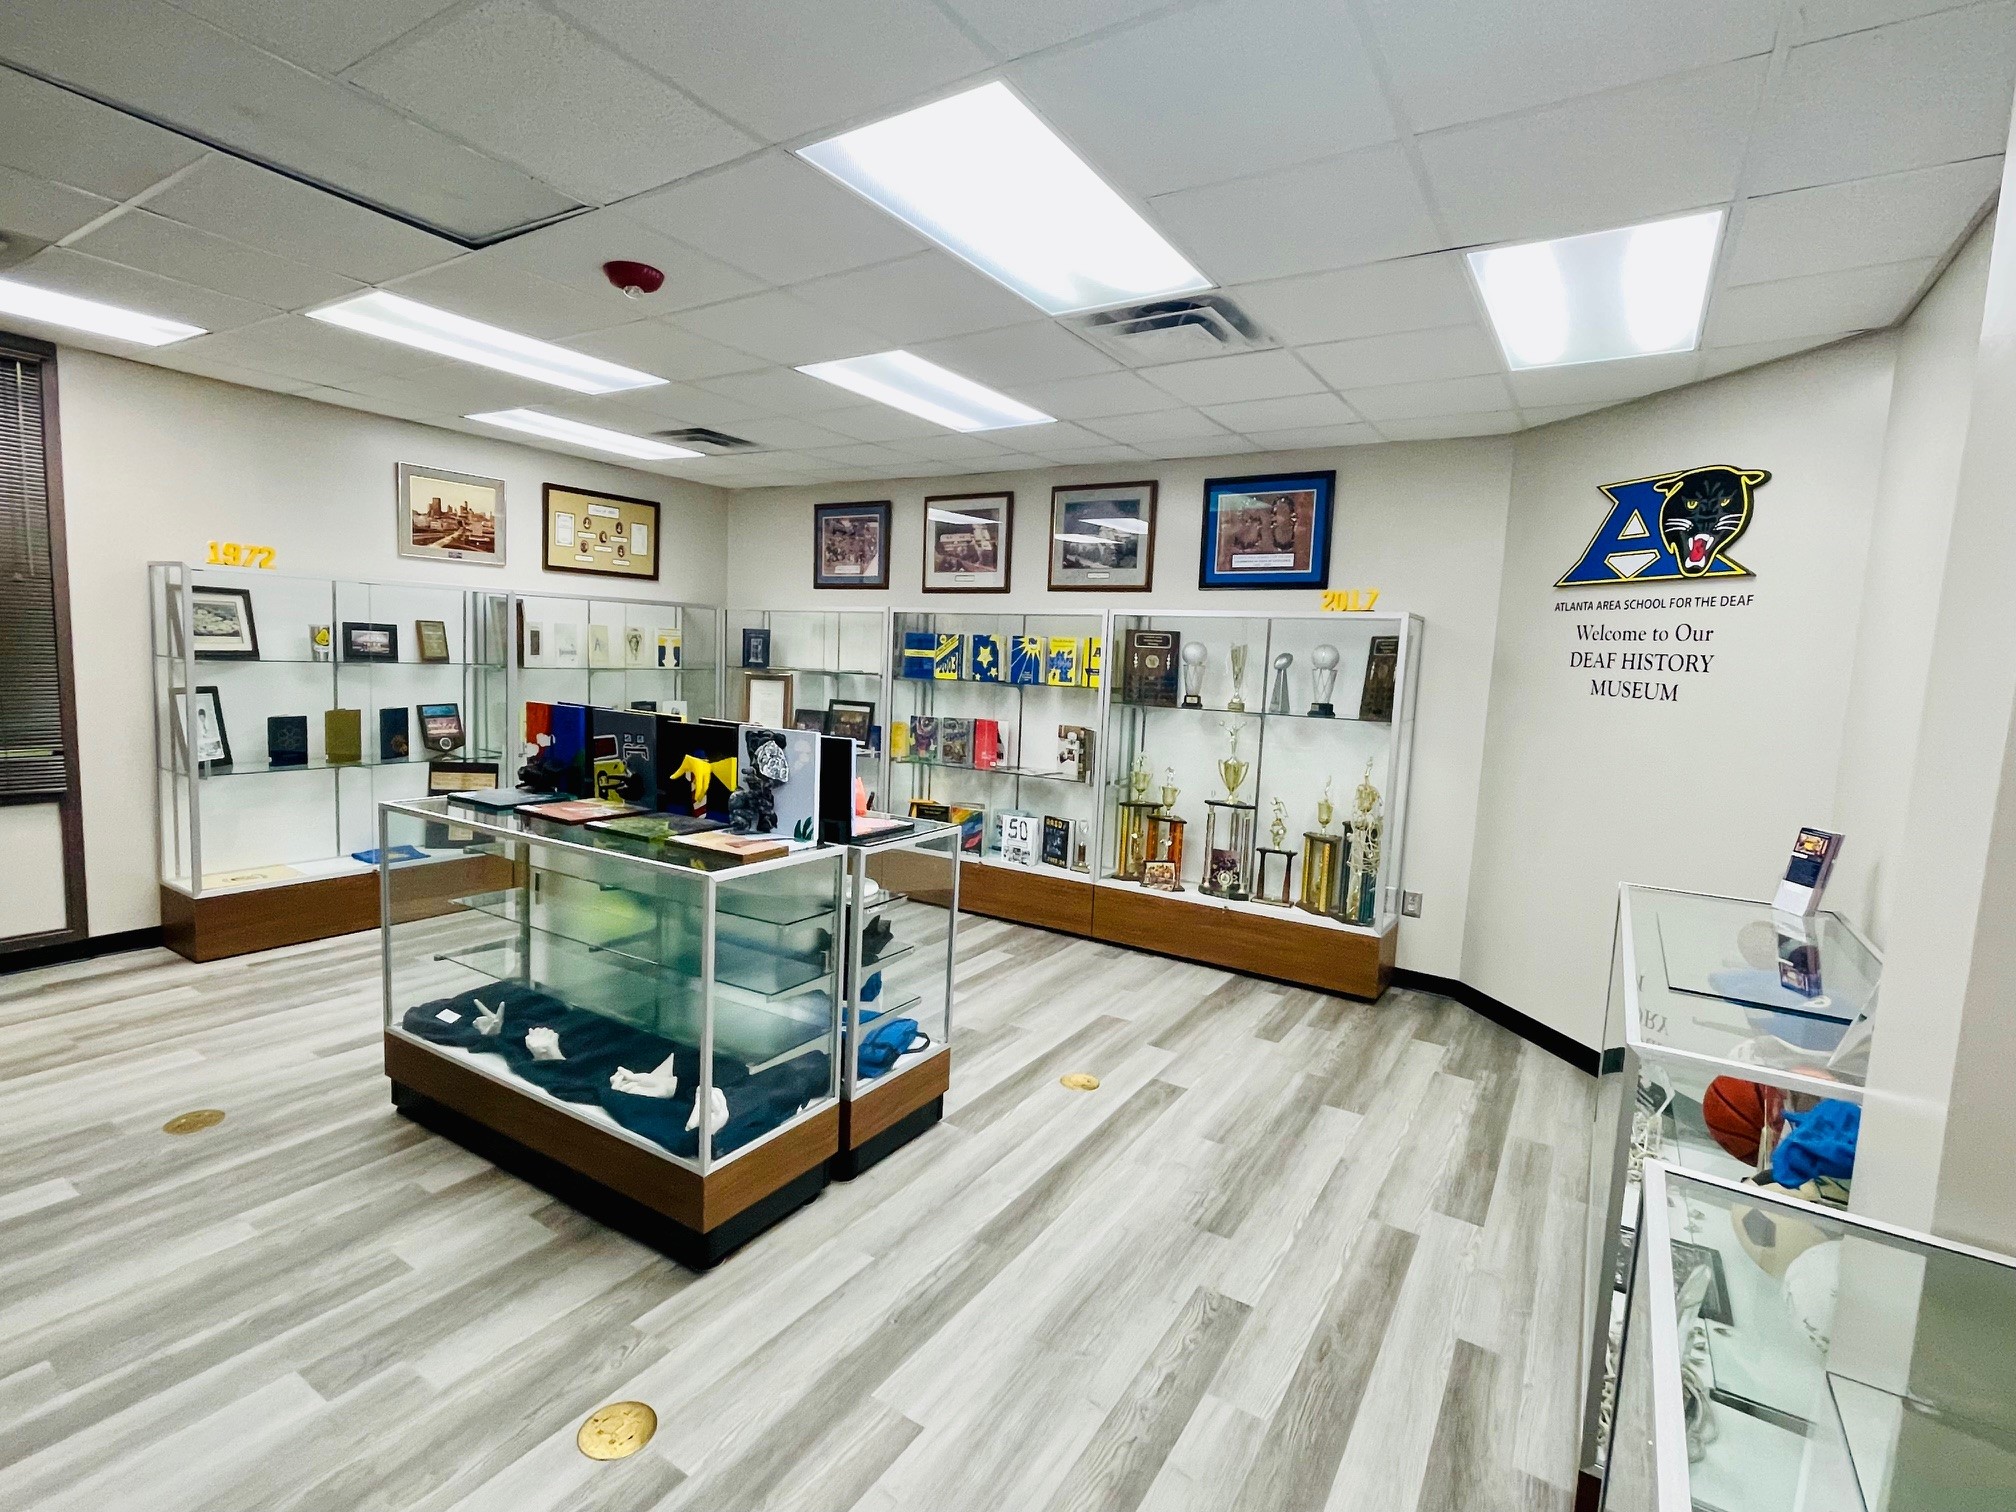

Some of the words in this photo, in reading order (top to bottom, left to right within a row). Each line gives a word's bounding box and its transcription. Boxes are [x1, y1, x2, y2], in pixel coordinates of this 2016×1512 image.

[205, 540, 277, 571] 1972
[1321, 588, 1379, 612] 2017
[1554, 601, 1594, 612] ATLANTA
[1596, 600, 1621, 610] AREA
[1623, 598, 1667, 610] SCHOOL
[1669, 597, 1692, 608] FOR
[1694, 596, 1717, 608] THE
[1719, 594, 1755, 607] DEAF
[1576, 624, 1647, 641] Welcome
[1652, 627, 1669, 641] to
[1675, 623, 1714, 642] Our
[1570, 651, 1617, 669] DEAF
[1621, 653, 1715, 673] HISTORY
[1590, 679, 1679, 702] MUSEUM
[1008, 817, 1028, 841] 50
